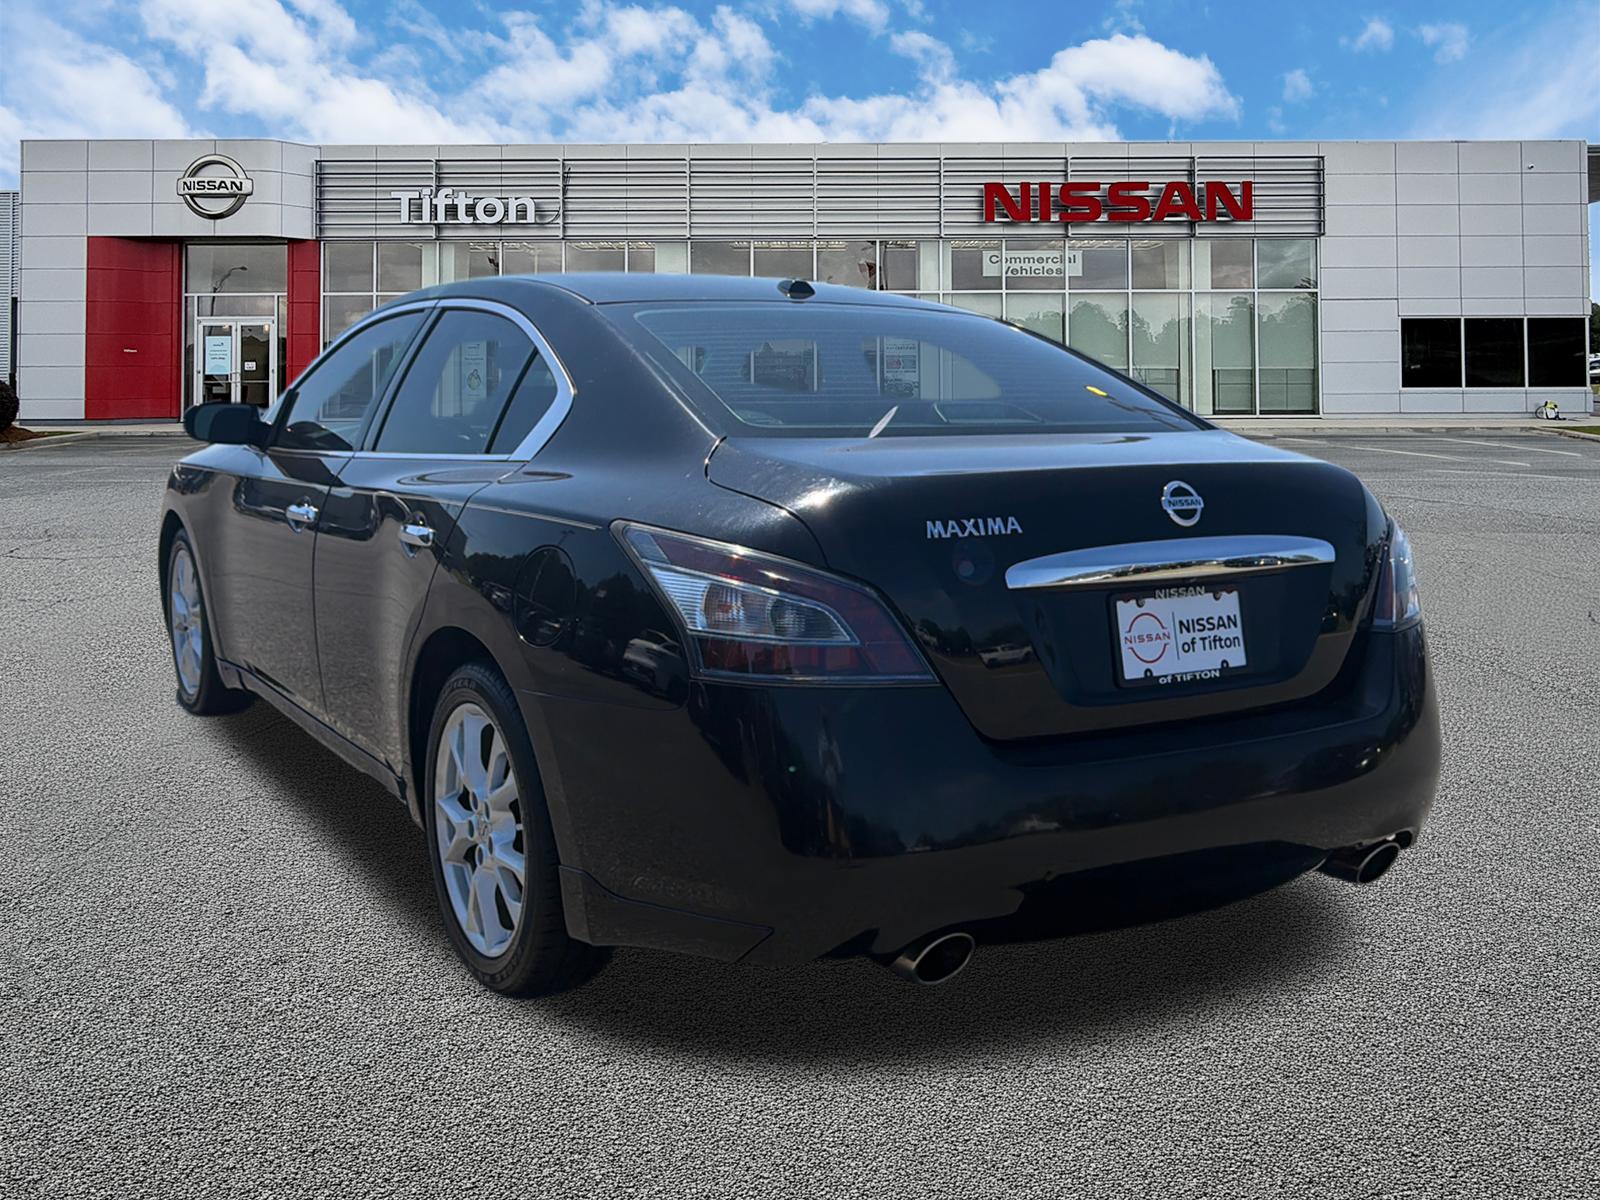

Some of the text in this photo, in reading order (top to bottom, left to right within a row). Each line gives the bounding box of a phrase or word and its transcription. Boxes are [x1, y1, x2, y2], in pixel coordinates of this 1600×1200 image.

[182, 180, 243, 191] NISSAN
[391, 188, 536, 224] Tifton
[984, 181, 1253, 222] NISSAN
[1005, 265, 1063, 276] Vehicles
[1168, 499, 1202, 508] NISSAN
[926, 516, 1023, 539] MAXIMA
[1154, 586, 1206, 600] NISSAN
[1178, 614, 1238, 634] NISSAN
[1124, 632, 1171, 645] NISSAN
[1181, 634, 1241, 653] of Tifton
[1158, 669, 1221, 685] of TIFTON
